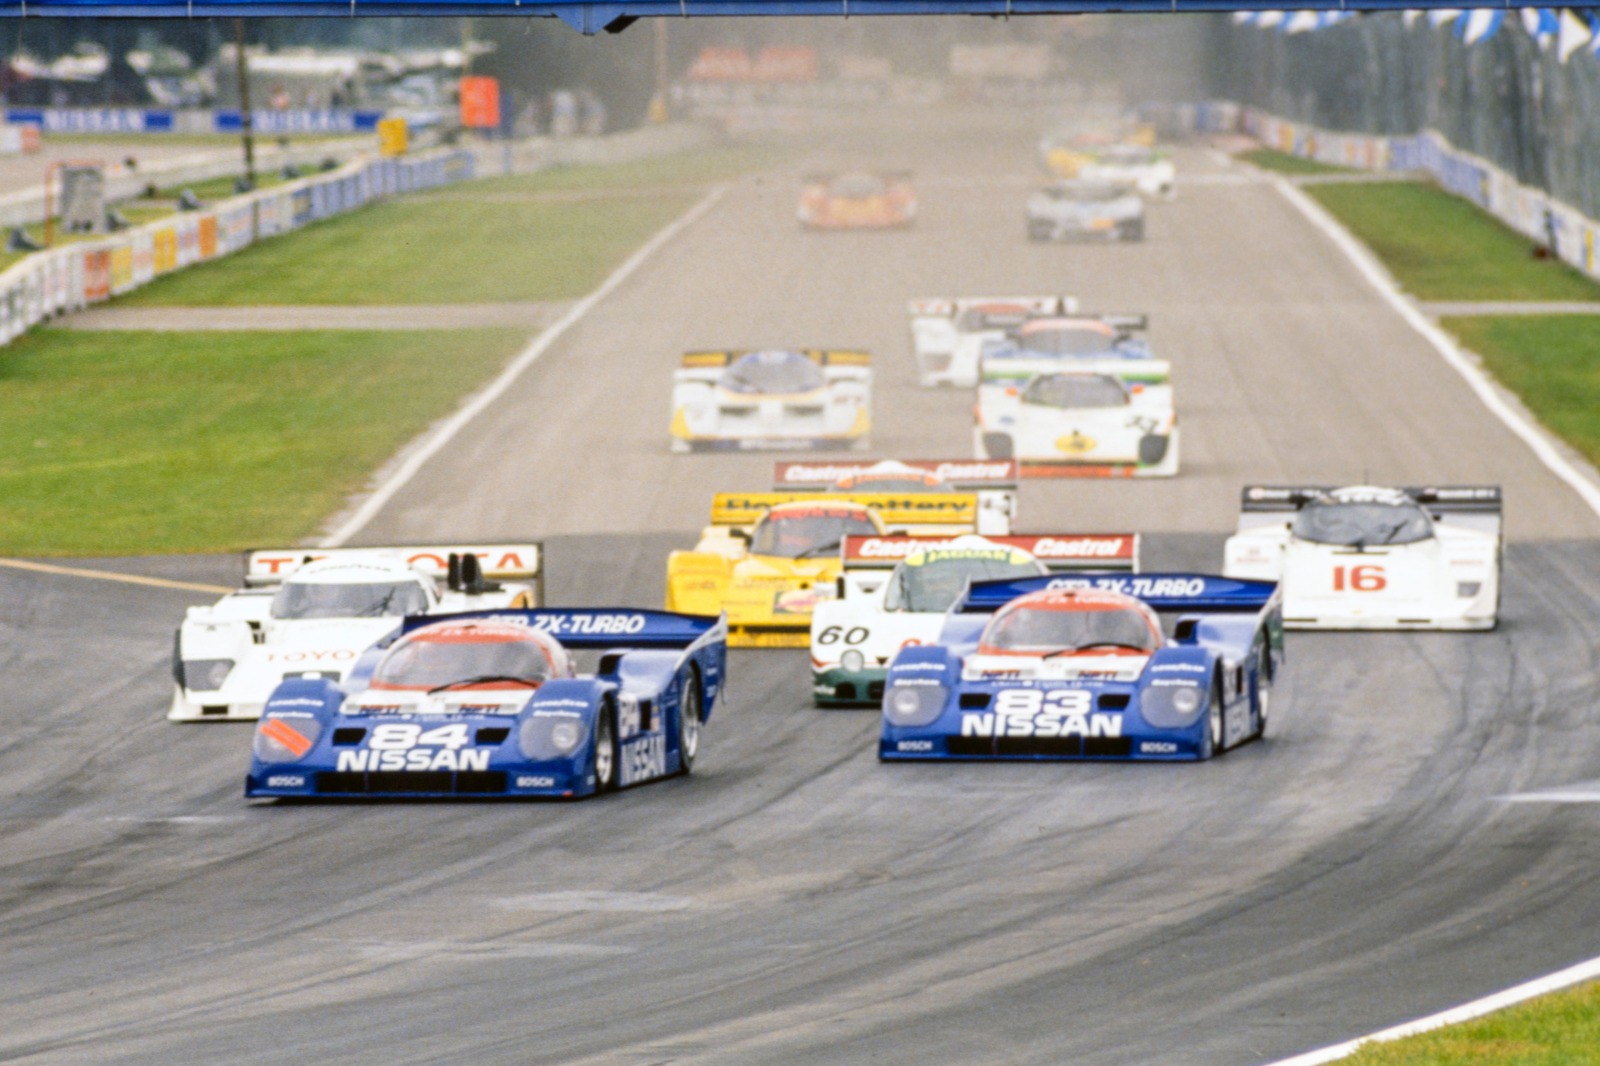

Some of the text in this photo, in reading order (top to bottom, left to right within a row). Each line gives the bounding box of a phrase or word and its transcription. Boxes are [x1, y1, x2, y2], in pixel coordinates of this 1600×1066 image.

[866, 499, 967, 512] ottery
[1032, 538, 1123, 557] Castrol
[1333, 564, 1387, 592] 16
[817, 625, 870, 645] 60
[265, 649, 355, 661] TOYO
[994, 688, 1092, 716] 83
[961, 713, 1123, 737] NISSAN
[369, 723, 469, 750] 84
[897, 741, 933, 752] BOSCH
[1140, 742, 1178, 753] BOSCH
[337, 748, 491, 772] NISSAN
[267, 775, 305, 787] BOSCH
[516, 776, 555, 787] BOSCH
